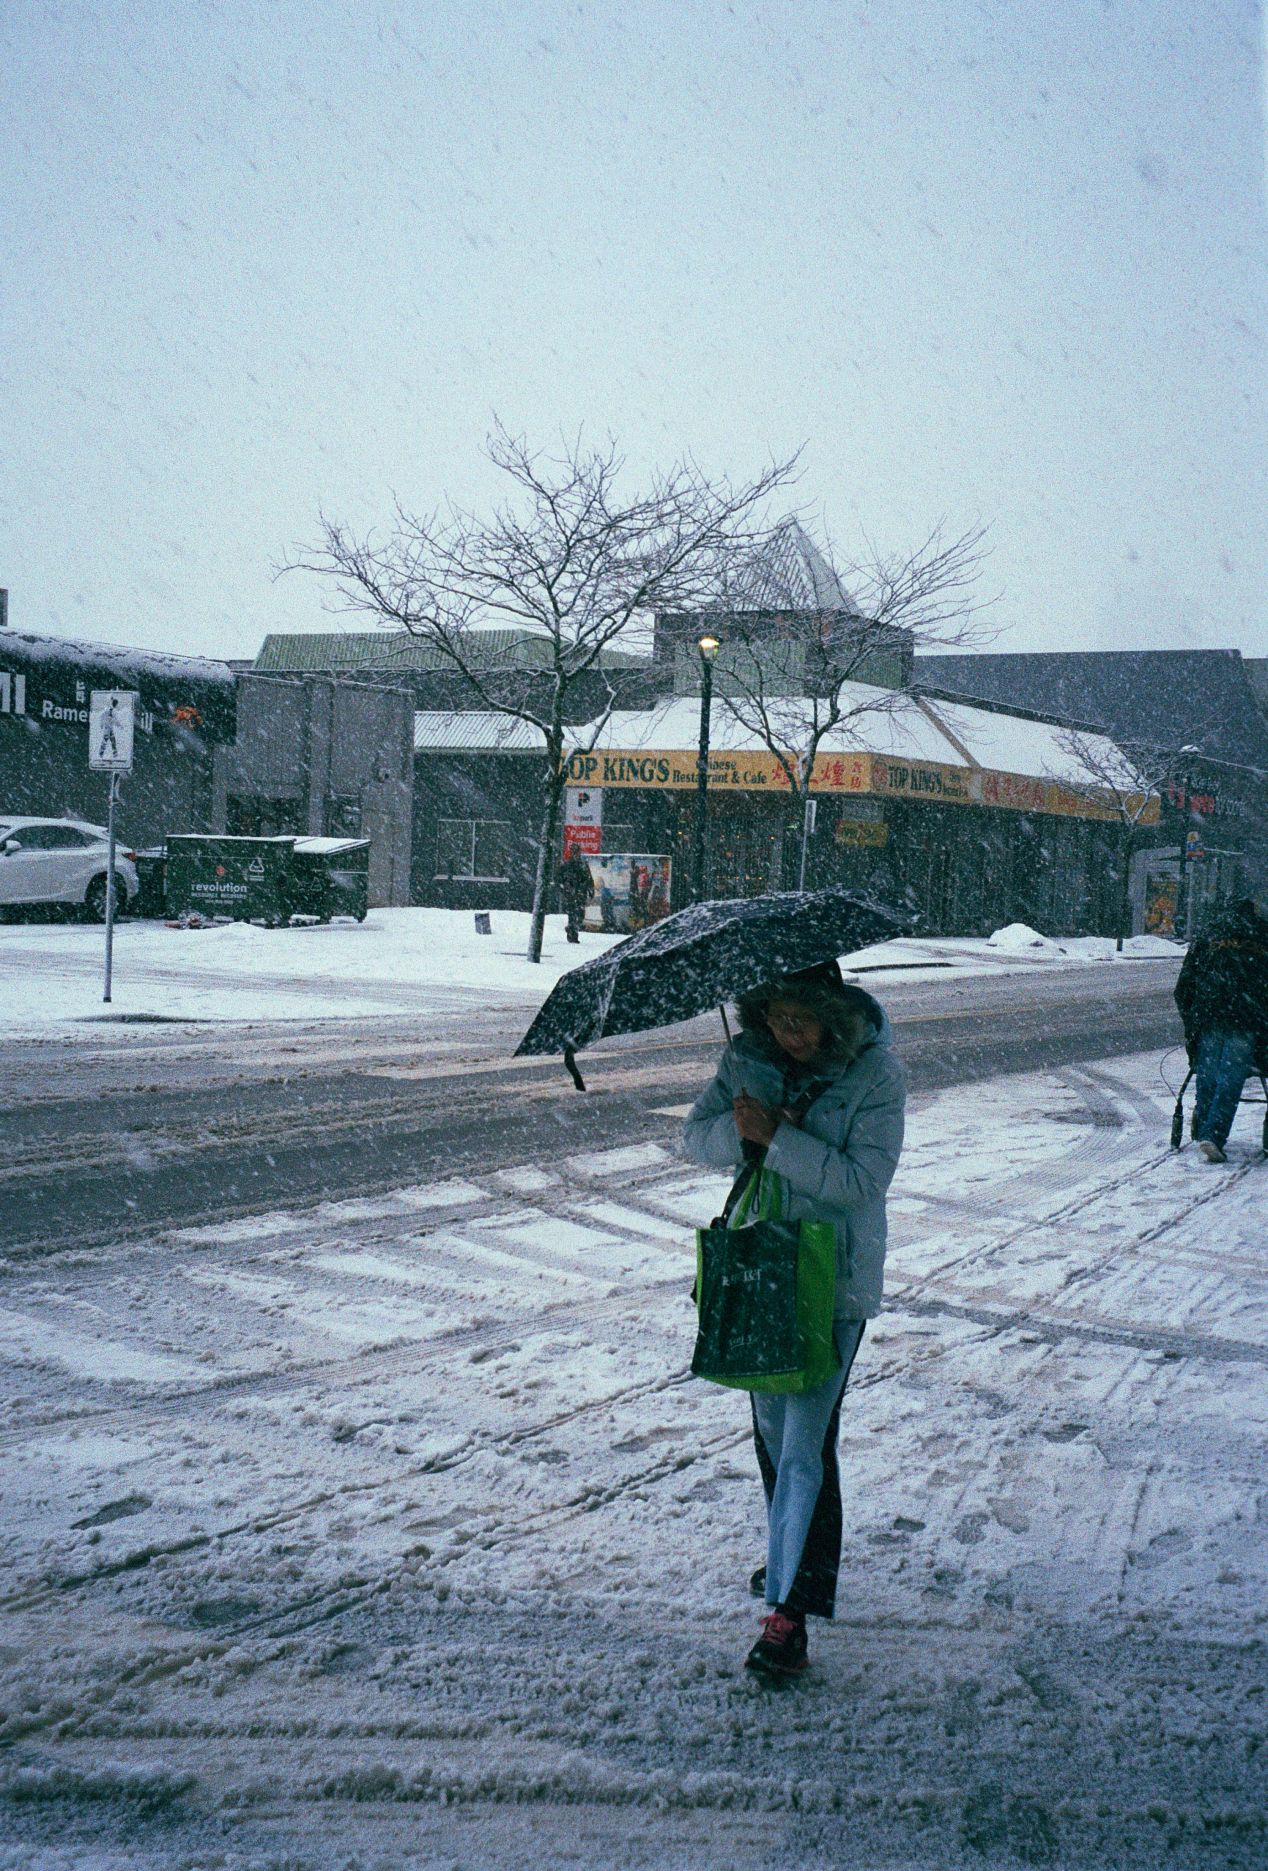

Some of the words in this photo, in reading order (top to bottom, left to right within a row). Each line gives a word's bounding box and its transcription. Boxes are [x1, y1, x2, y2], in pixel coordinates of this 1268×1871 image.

[42, 699, 90, 722] Rame
[561, 757, 598, 780] OP
[603, 757, 670, 783] KING'S
[672, 769, 728, 783] Restarant
[567, 840, 599, 851] Prking
[191, 881, 248, 893] revolution
